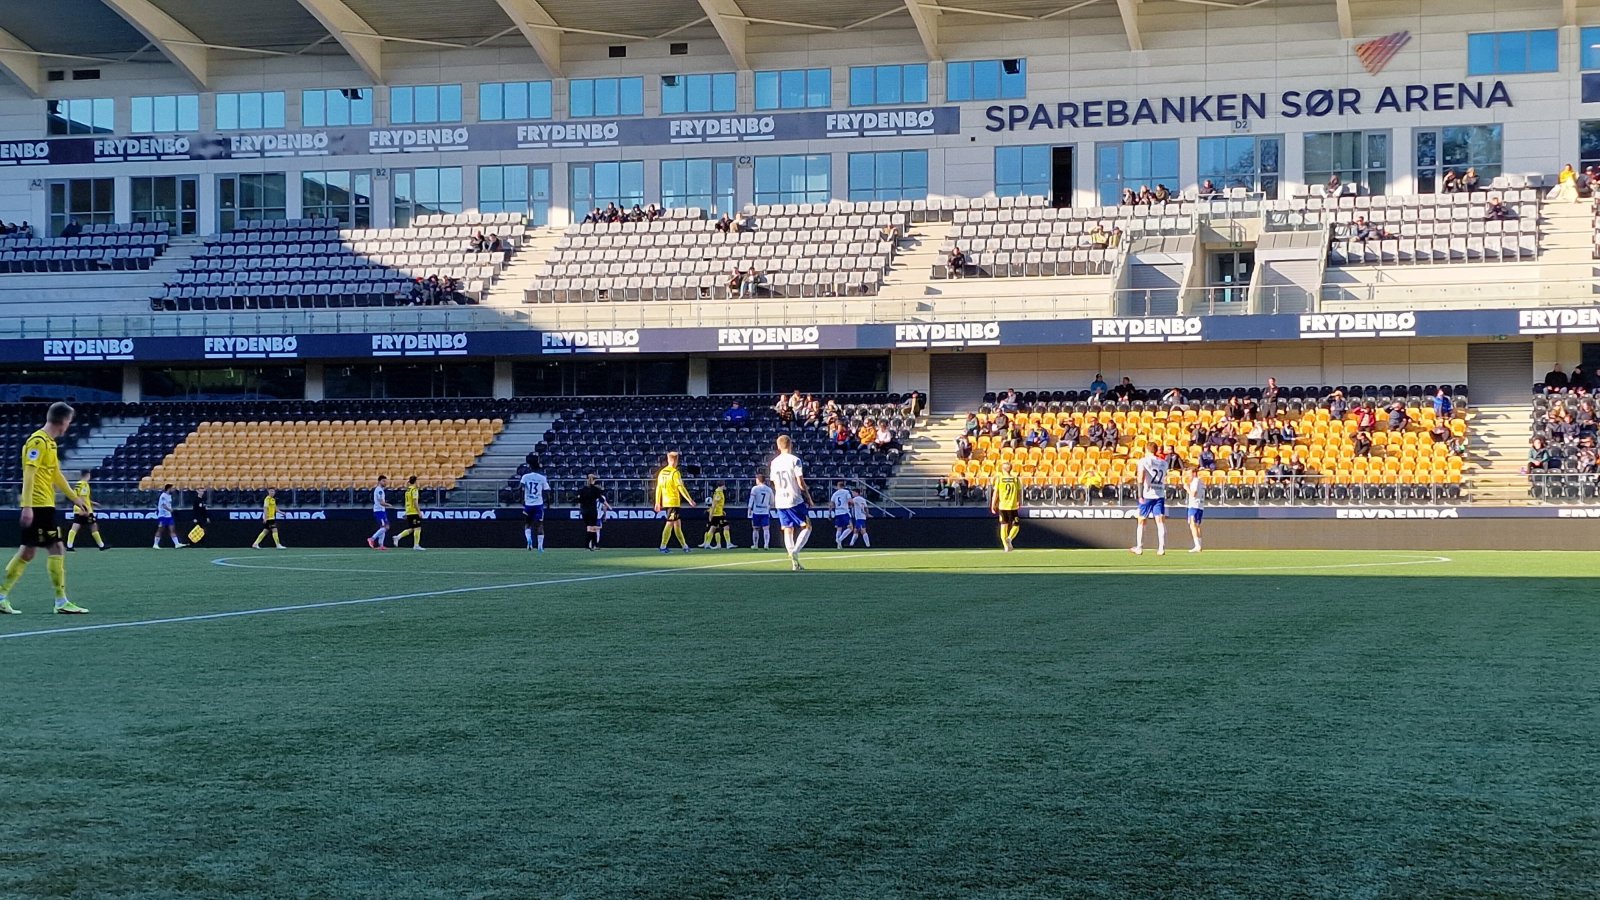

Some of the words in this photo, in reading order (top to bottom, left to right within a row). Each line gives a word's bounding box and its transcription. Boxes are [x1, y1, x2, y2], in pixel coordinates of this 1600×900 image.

[985, 92, 1266, 132] SPAREBANKEN
[1281, 88, 1361, 118] SØR
[1375, 80, 1513, 113] ARENA
[670, 116, 775, 137] FRYDENBØ
[827, 109, 935, 131] FRYDENBØ
[1235, 120, 1248, 129] D2
[369, 126, 469, 148] FRYDENBØ
[517, 121, 618, 142] FRYDENBØ
[94, 137, 190, 156] FRYDENBØ
[231, 131, 328, 152] FRYDENBØ
[739, 156, 751, 165] C2
[376, 168, 386, 177] B2
[31, 179, 42, 187] A2
[1091, 315, 1203, 336] FRYDENBØ
[1299, 310, 1416, 333] FRYDENBØ
[372, 332, 468, 351] FRYDENBØ
[541, 328, 640, 348] FRYDENBØ
[718, 325, 820, 345] FRYDENBØ
[895, 322, 1001, 342] FRYDENBØ
[44, 338, 134, 355] FRYDENBØ
[204, 335, 298, 353] FRYDENBØ
[1151, 469, 1164, 485] 22
[528, 481, 539, 495] 13
[761, 493, 766, 504] 7
